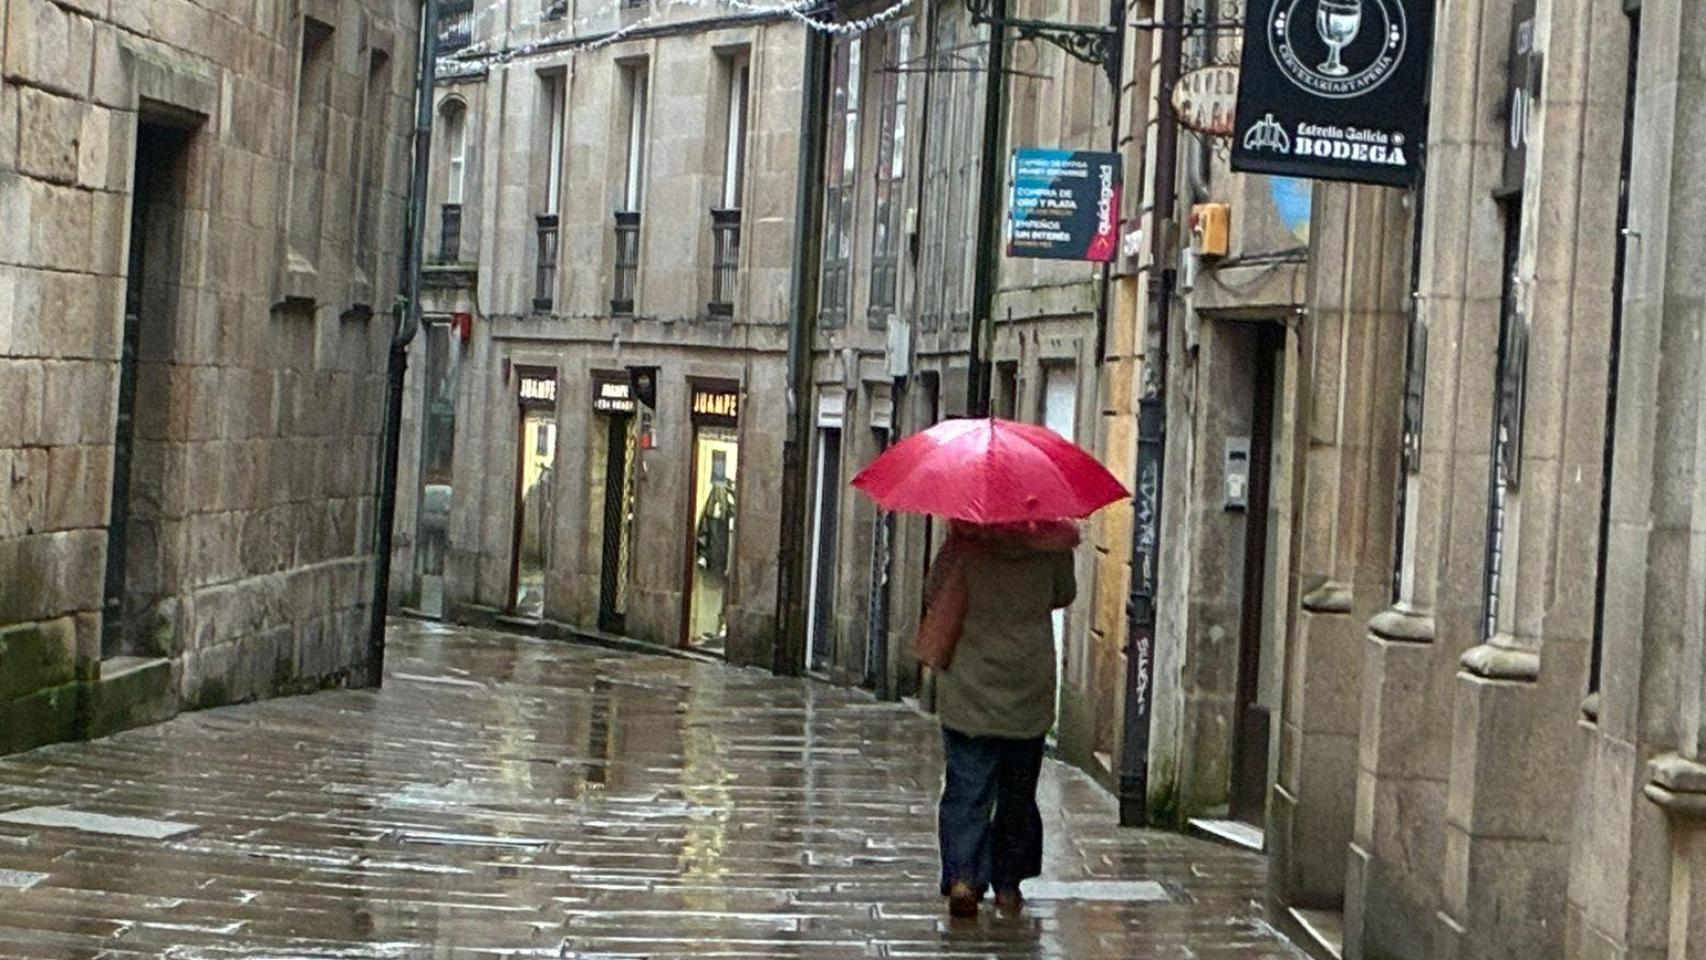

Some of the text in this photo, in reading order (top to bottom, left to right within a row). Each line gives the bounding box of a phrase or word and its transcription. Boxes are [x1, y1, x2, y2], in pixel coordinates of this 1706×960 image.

[1297, 122, 1388, 145] Estrella Galicia
[1295, 136, 1407, 166] BODEGA
[1016, 198, 1078, 210] ORO Y PLATA
[1059, 188, 1073, 199] DE
[1097, 164, 1113, 236] quickgold
